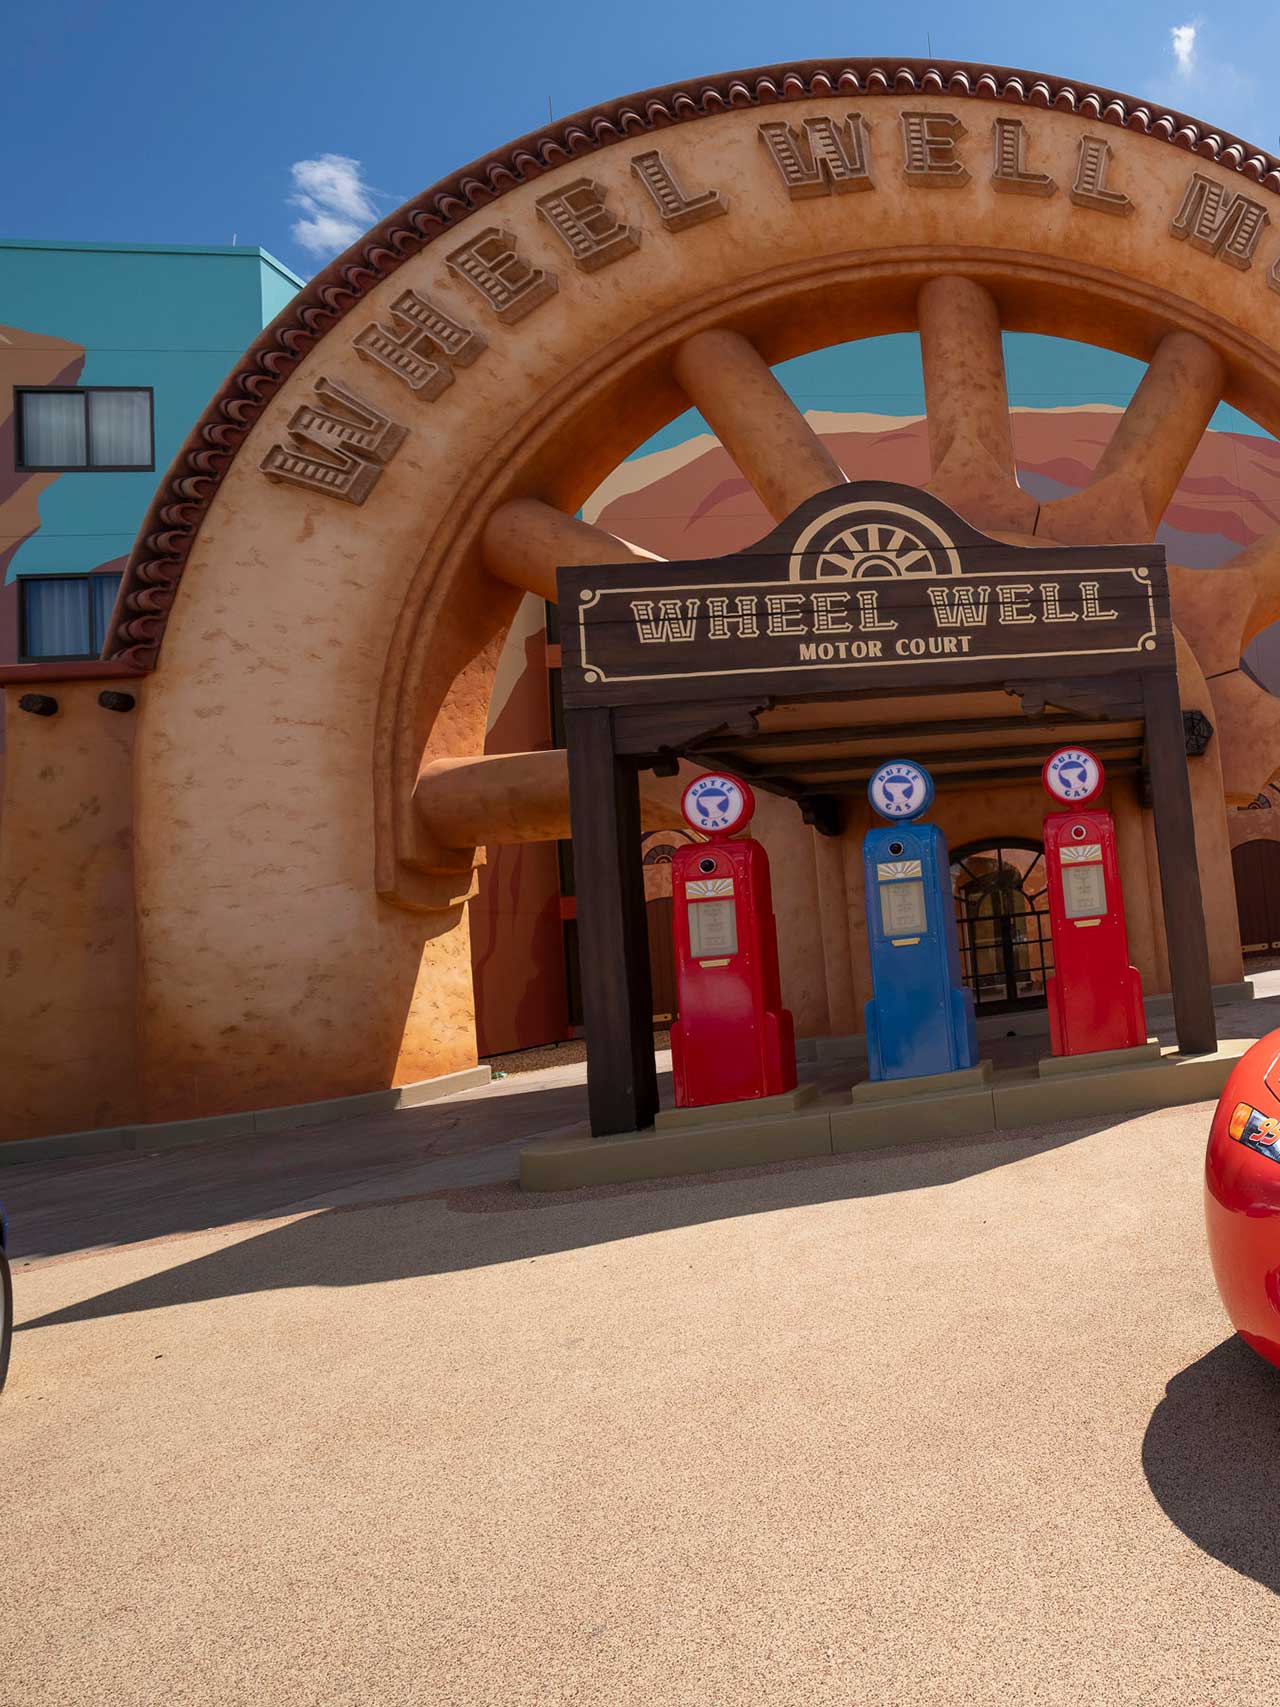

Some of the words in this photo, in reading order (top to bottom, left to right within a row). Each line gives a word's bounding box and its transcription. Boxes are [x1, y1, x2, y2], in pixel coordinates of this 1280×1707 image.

[259, 150, 729, 506] WHEEL
[757, 111, 1133, 215] WELL
[630, 590, 898, 644] WHEEL
[927, 581, 1119, 628] WELL
[799, 640, 883, 661] MOTOR
[896, 636, 972, 656] COURT
[1052, 753, 1090, 770] BUTTE
[878, 767, 919, 783] BUTTE
[691, 780, 735, 797] BUTTE
[1064, 787, 1089, 798] GAS
[885, 803, 912, 812] GAS
[701, 817, 729, 828] GAS
